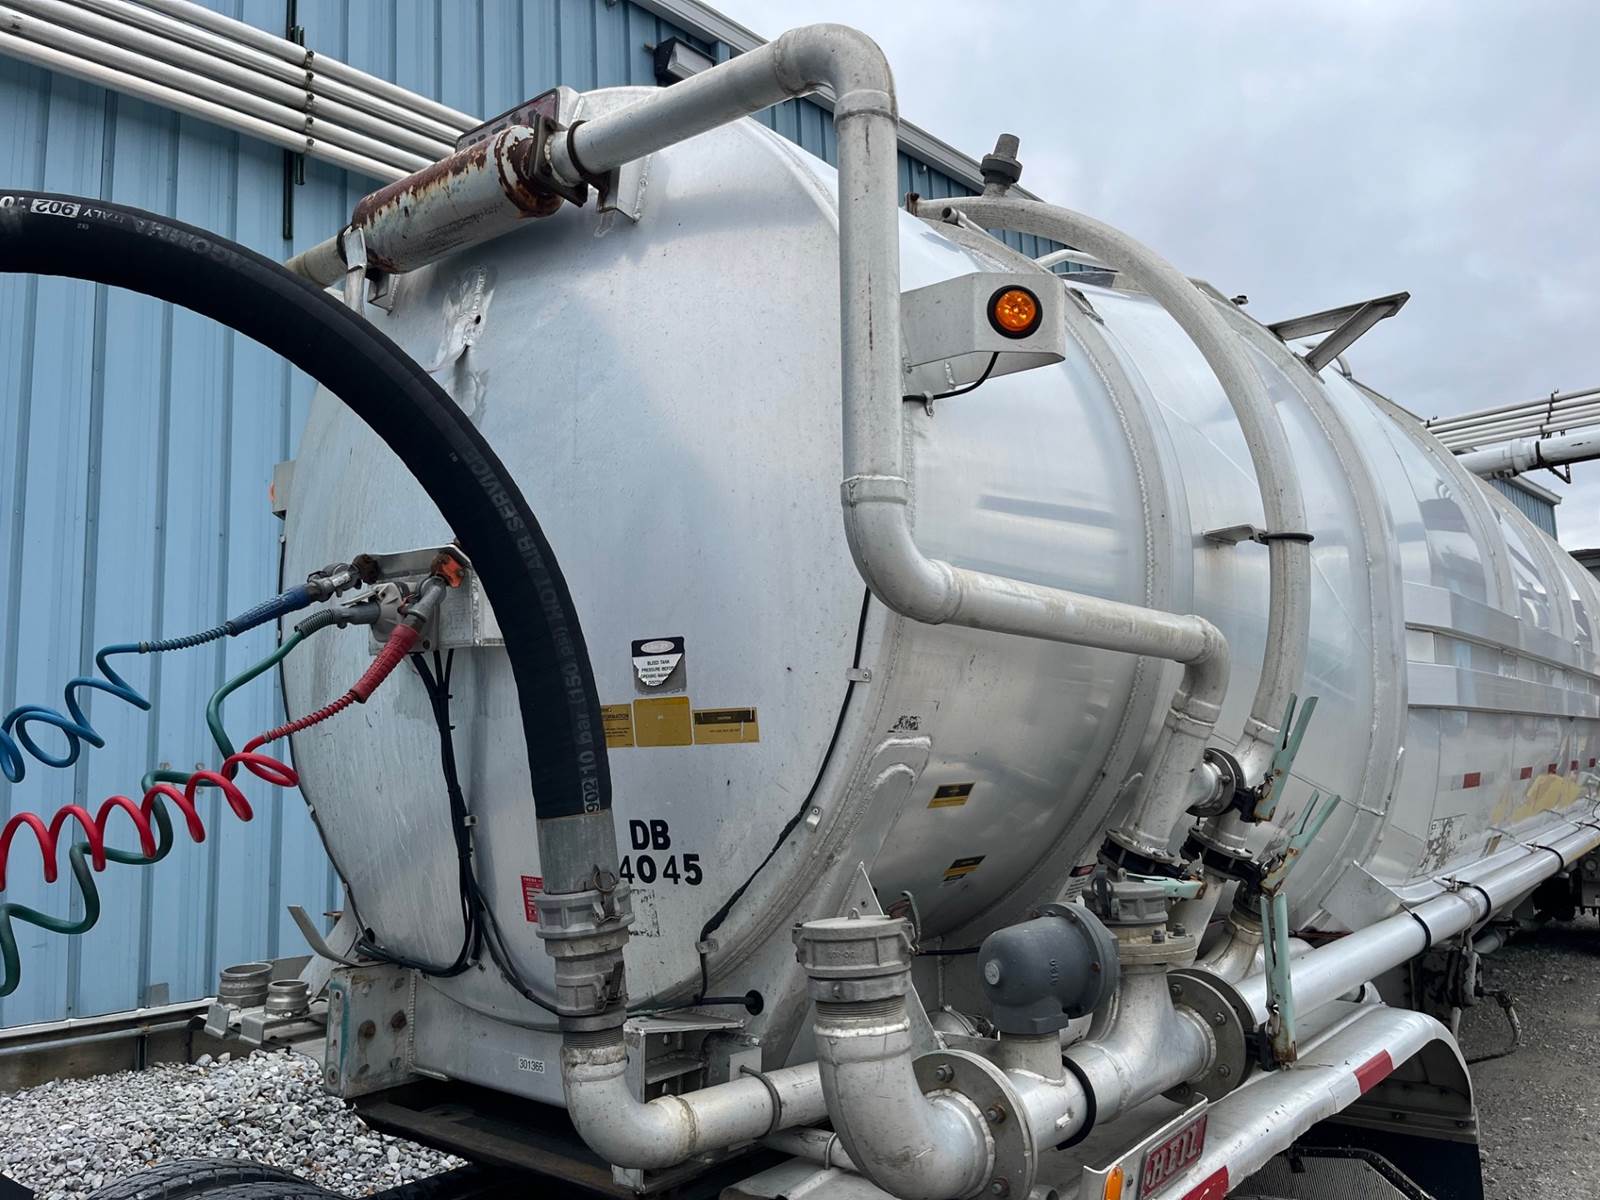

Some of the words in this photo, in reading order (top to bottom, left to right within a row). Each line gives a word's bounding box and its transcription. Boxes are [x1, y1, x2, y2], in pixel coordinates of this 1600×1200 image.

[35, 200, 76, 217] 902
[462, 448, 526, 532] SERVICE
[575, 711, 594, 745] bar
[583, 780, 600, 813] 902
[629, 819, 671, 851] DB
[619, 853, 703, 886] 4045
[519, 1058, 544, 1072] 301365
[1145, 1125, 1198, 1187] HEIL
